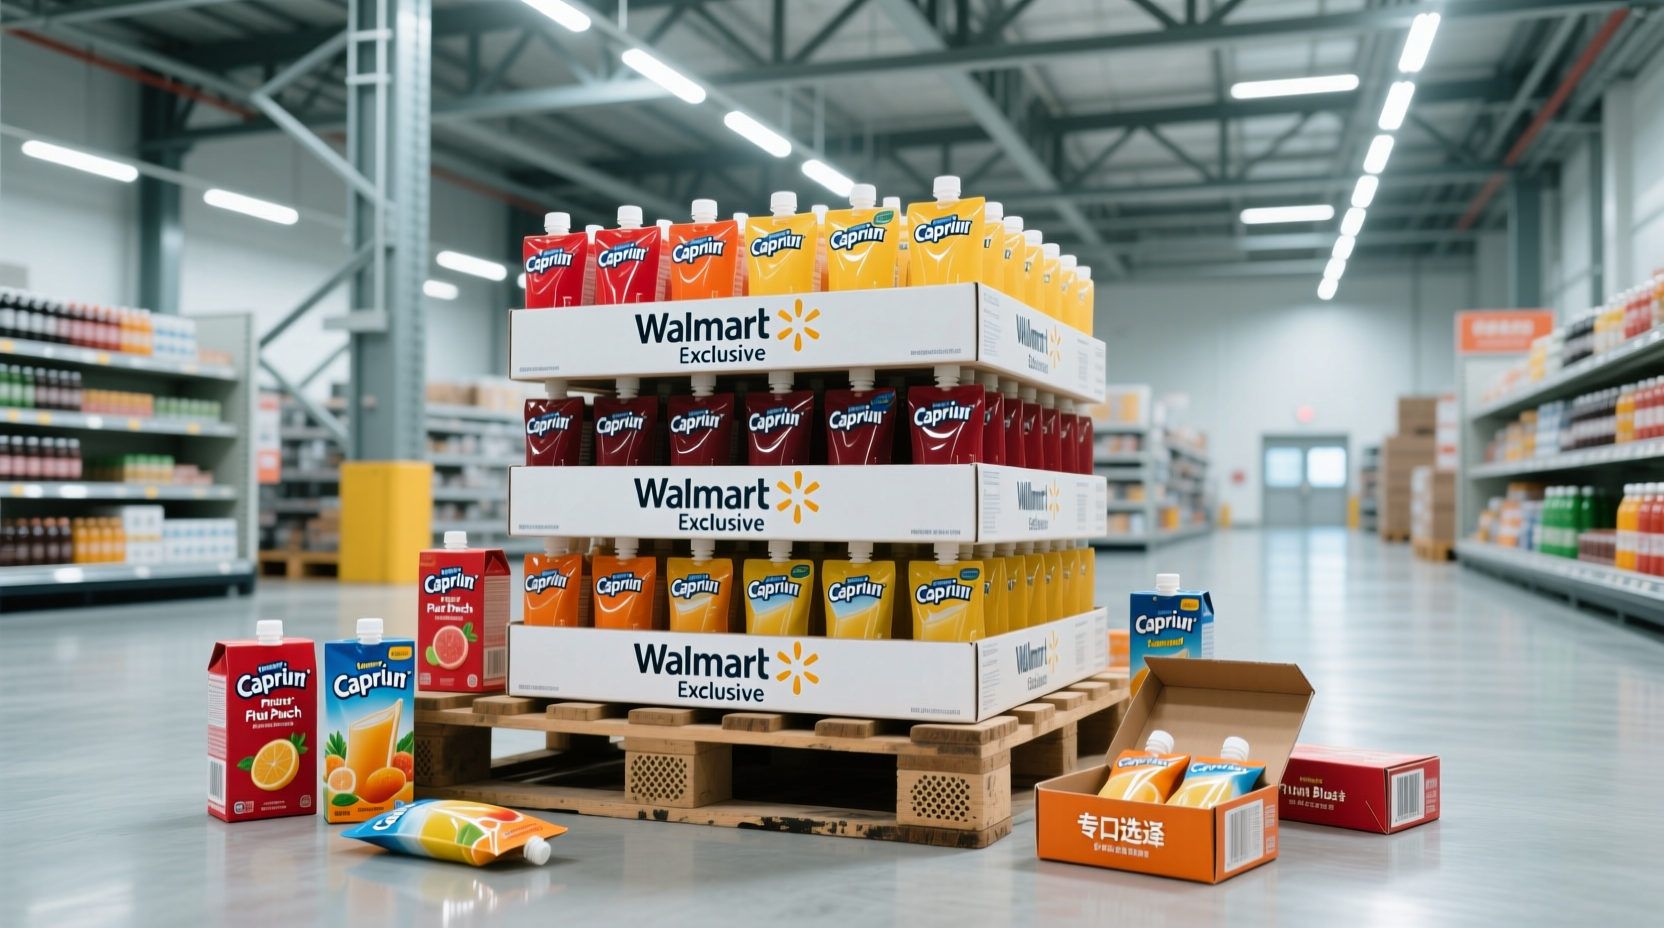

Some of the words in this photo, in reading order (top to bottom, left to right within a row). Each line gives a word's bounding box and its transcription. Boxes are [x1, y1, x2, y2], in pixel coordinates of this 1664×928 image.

[635, 308, 769, 344] Walmart
[679, 345, 765, 364] Exclusive
[634, 478, 769, 510] Walmart
[678, 512, 764, 532] Exclusive
[634, 643, 769, 680] Walmart
[678, 681, 764, 702] Exclusive
